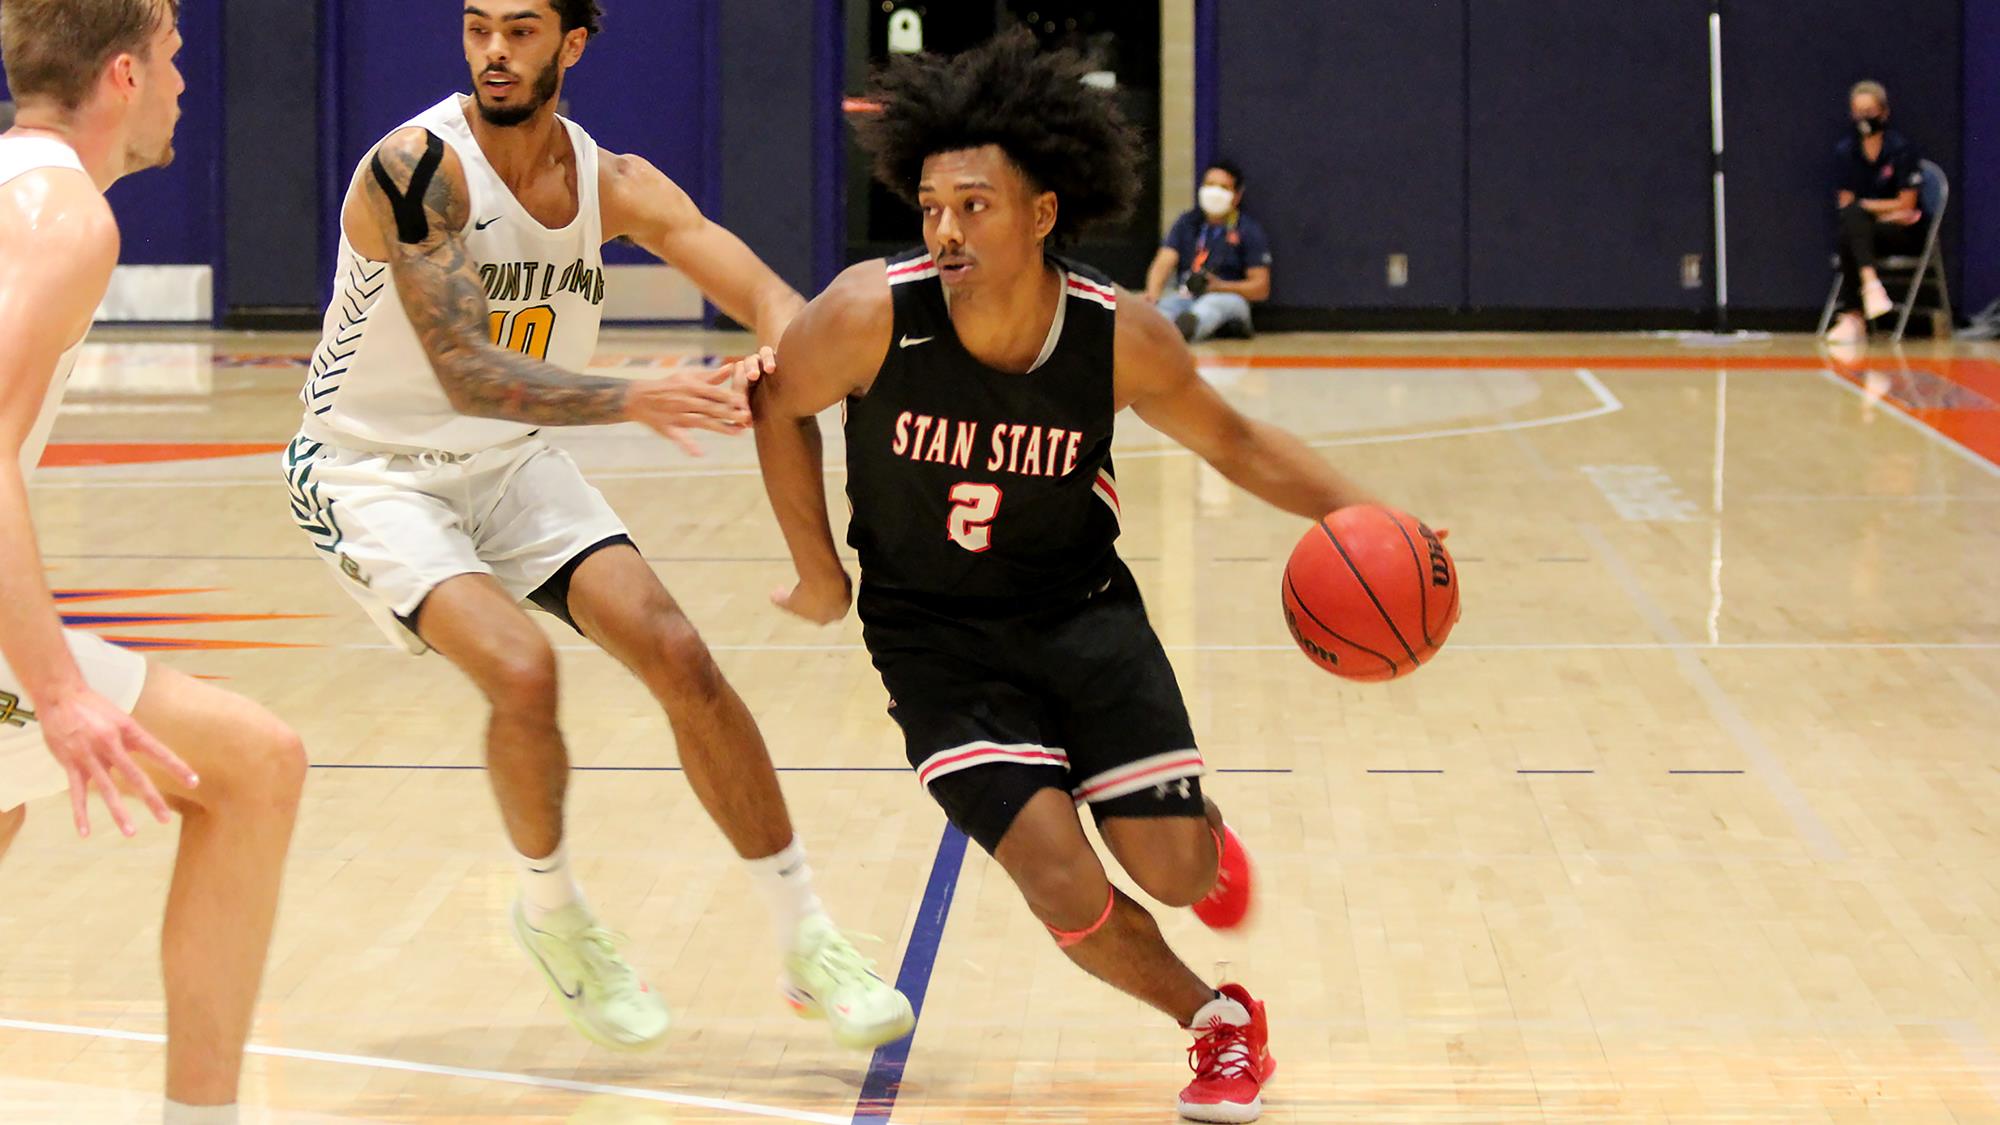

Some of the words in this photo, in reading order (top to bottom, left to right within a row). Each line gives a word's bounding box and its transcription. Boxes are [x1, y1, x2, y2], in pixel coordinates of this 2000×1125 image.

[477, 261, 539, 301] OINT
[892, 411, 977, 470] STAN
[986, 422, 1083, 477] STATE
[946, 481, 1003, 553] 2
